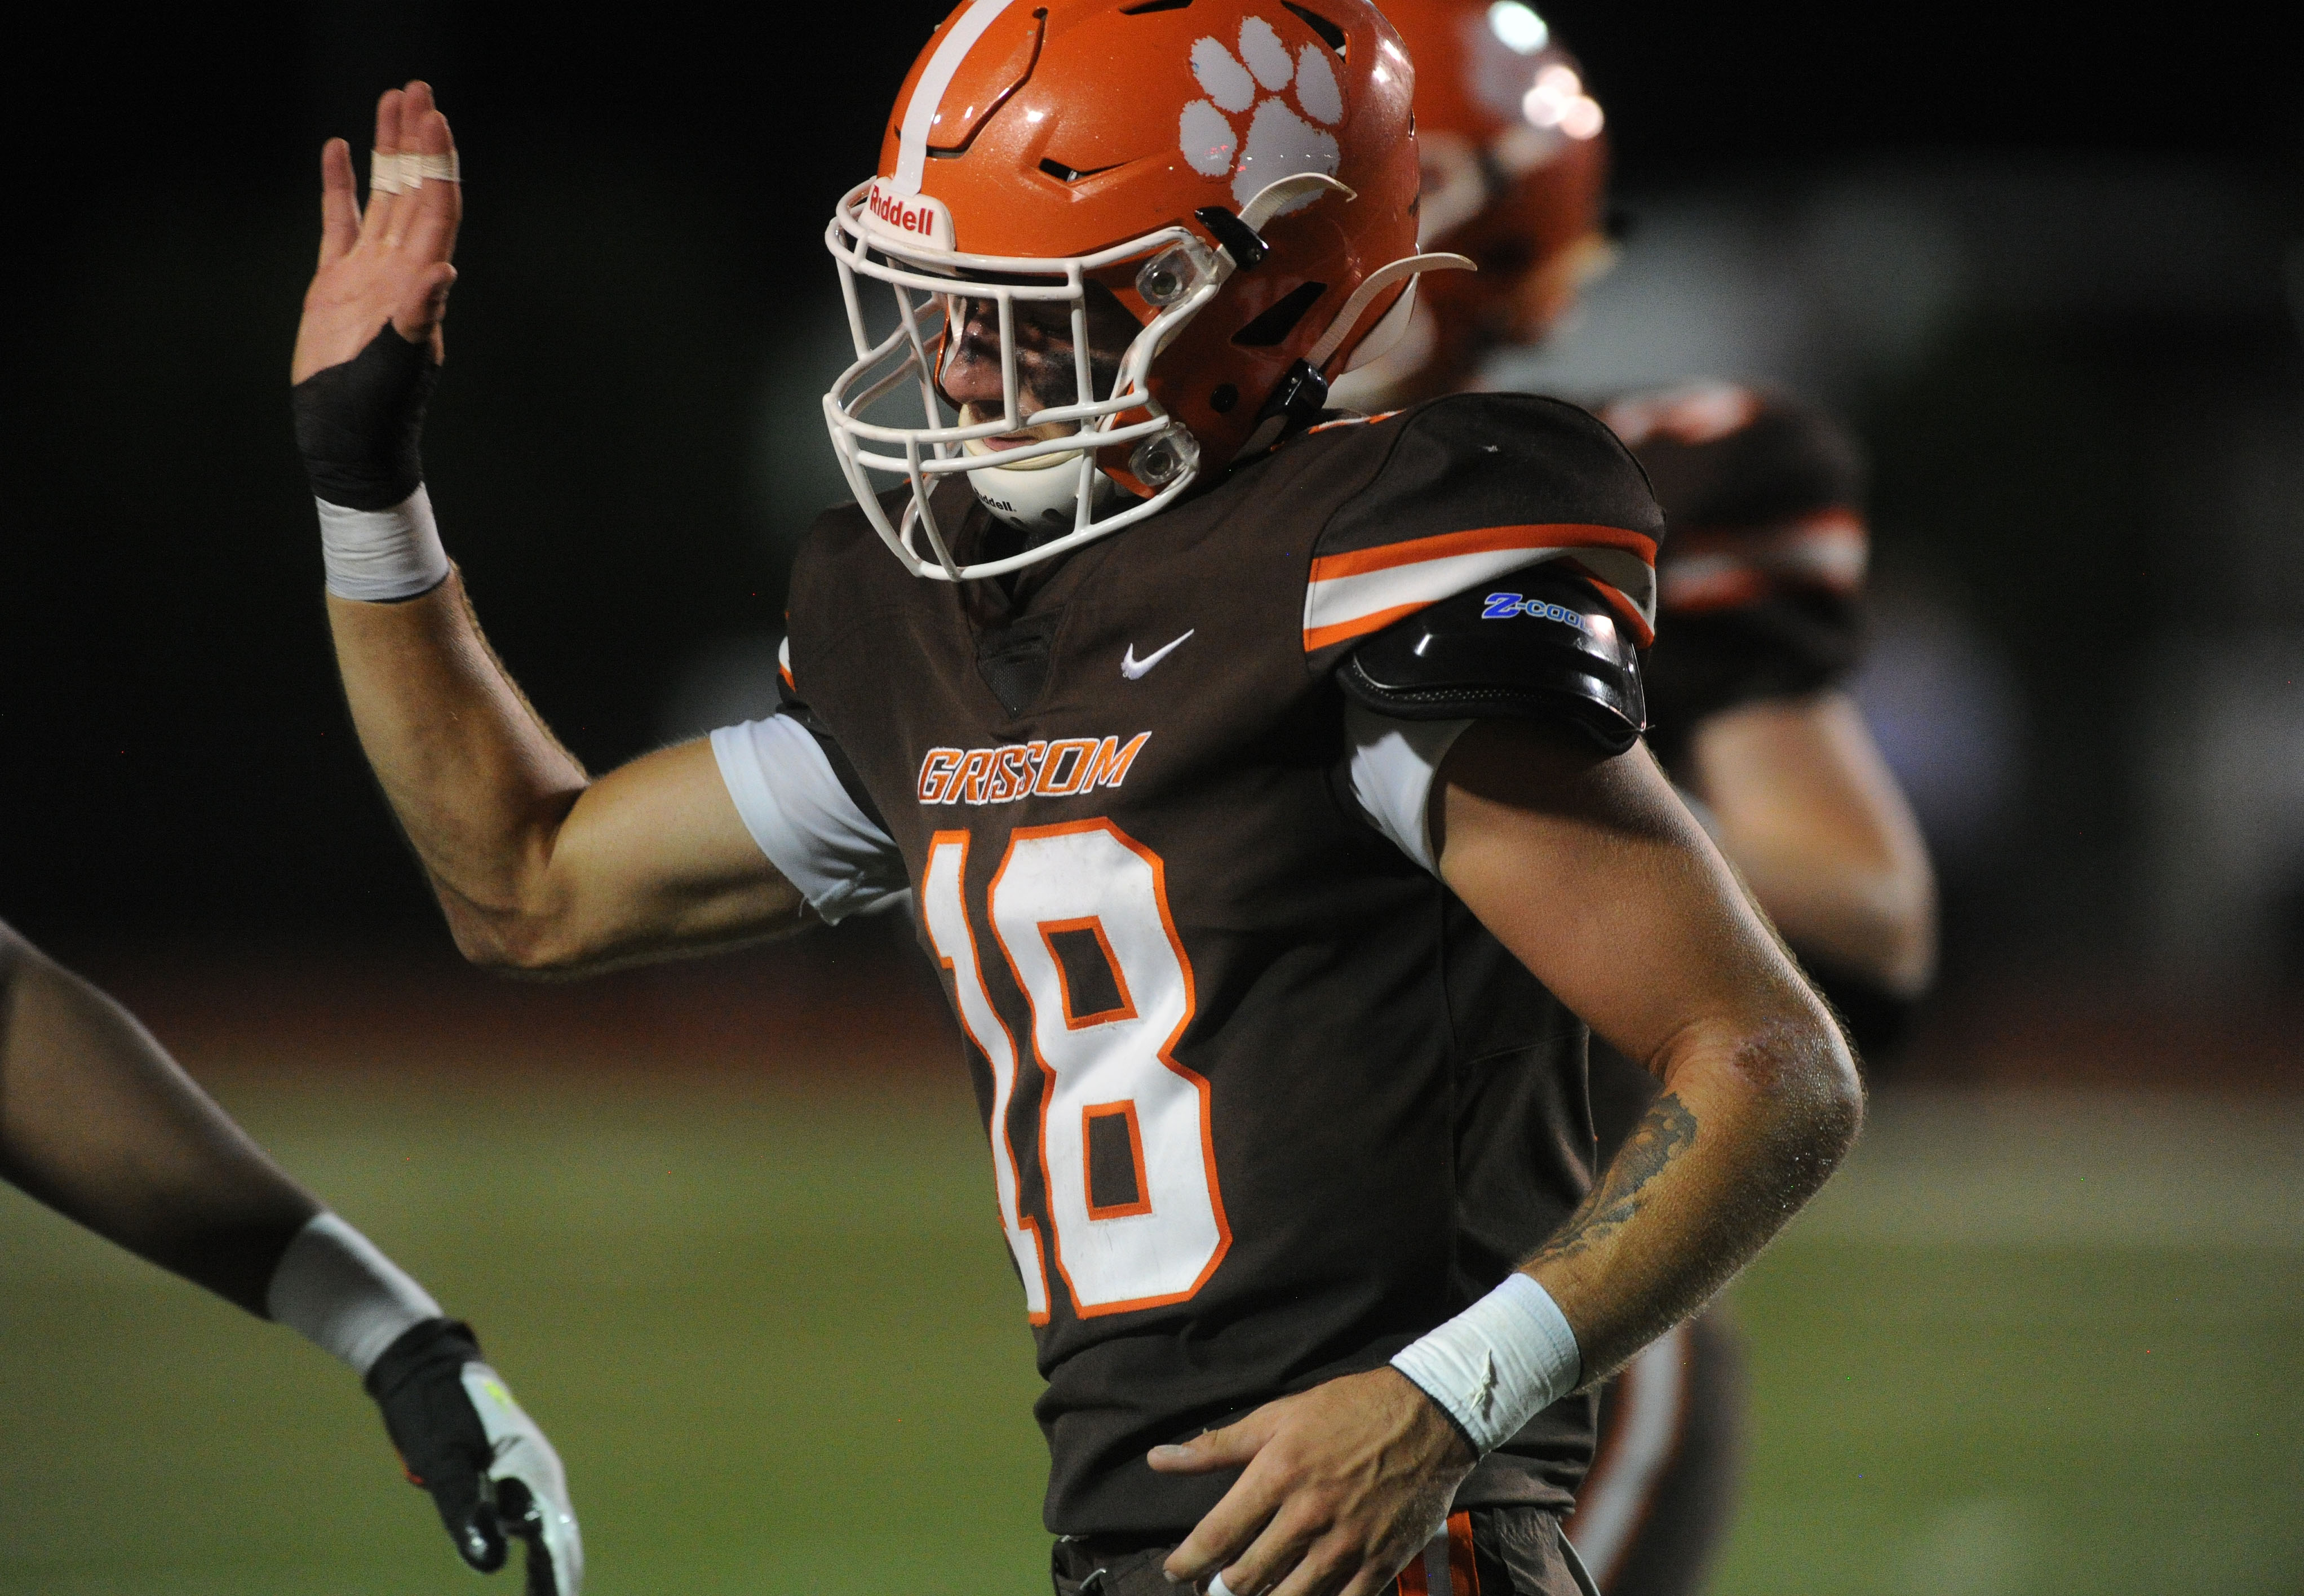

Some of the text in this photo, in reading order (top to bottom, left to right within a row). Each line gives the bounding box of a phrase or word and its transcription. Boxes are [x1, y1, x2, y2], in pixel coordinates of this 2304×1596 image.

[870, 185, 934, 236] Riddell
[917, 730, 1153, 806] GRISSOM
[922, 817, 1233, 1327] 18
